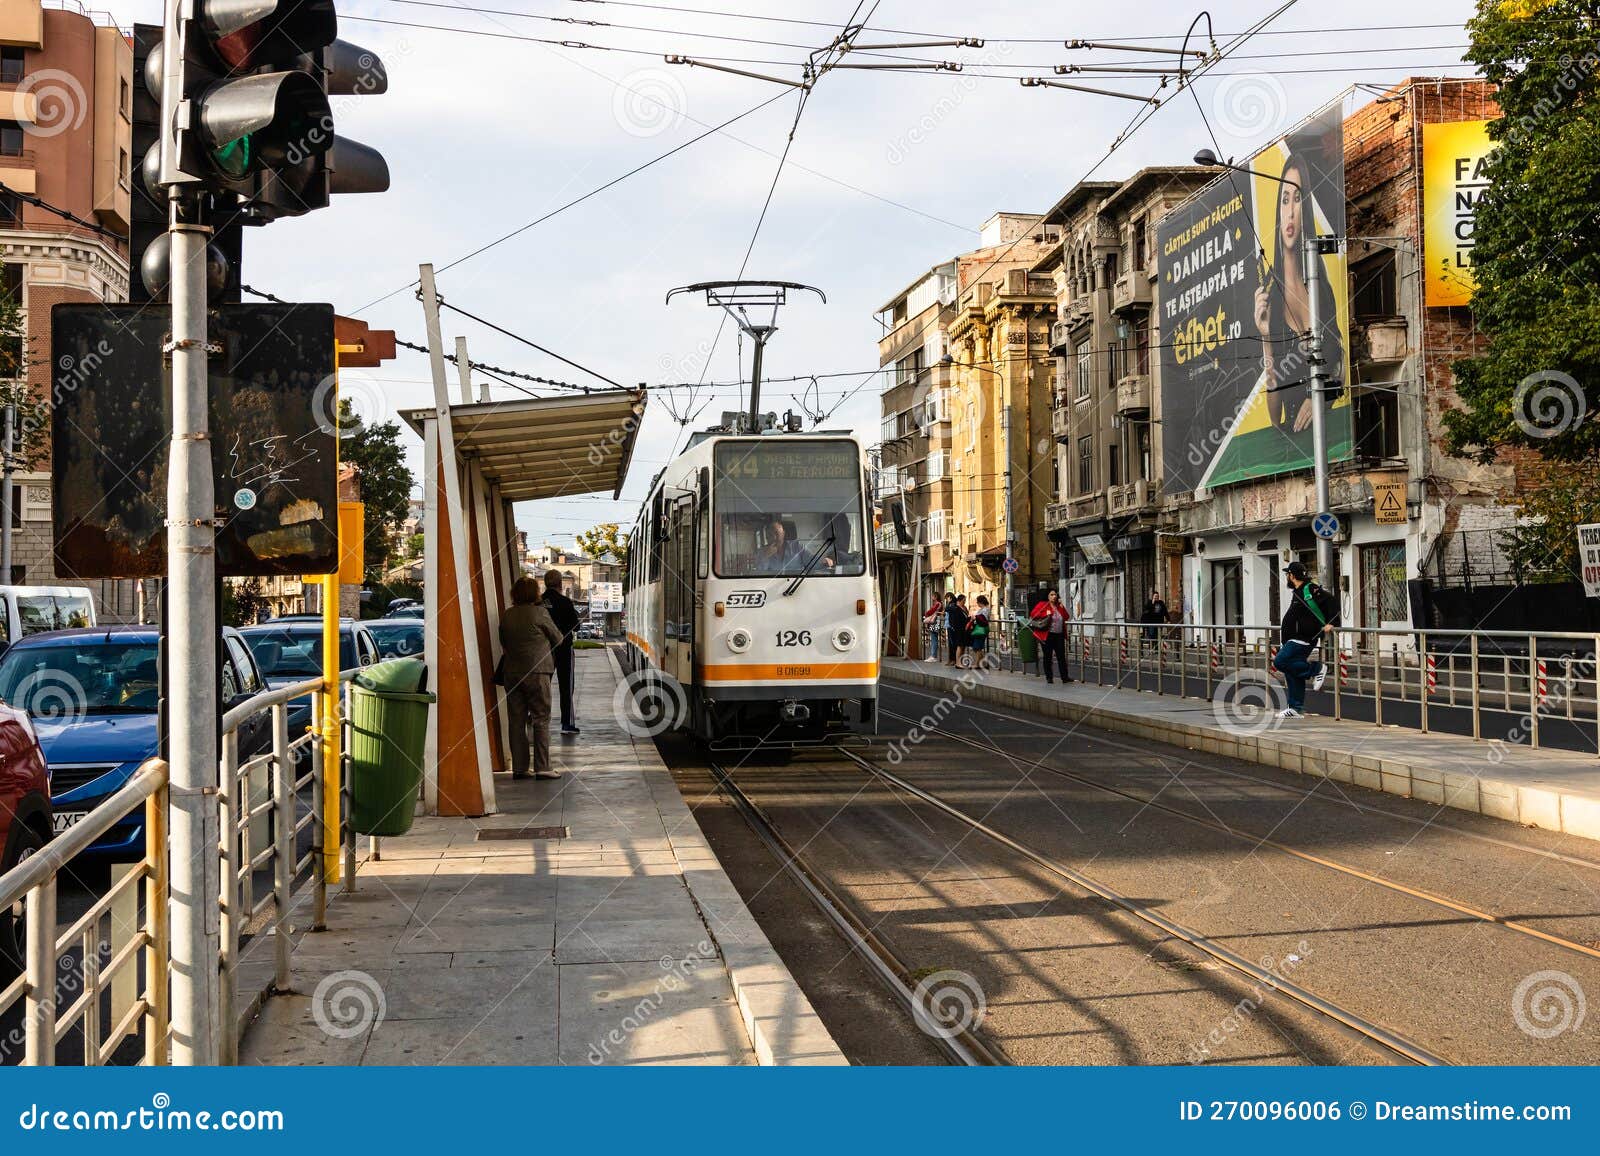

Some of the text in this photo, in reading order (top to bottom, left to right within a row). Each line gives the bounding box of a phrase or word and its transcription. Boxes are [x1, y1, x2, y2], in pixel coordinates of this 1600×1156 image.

[1191, 215, 1210, 239] SUNT
[1173, 229, 1233, 284] DANIELA
[1165, 260, 1245, 319] TE AȘTEAPTĂ PE
[726, 455, 759, 478] 44
[1581, 528, 1600, 545] TERE
[775, 630, 812, 647] 126
